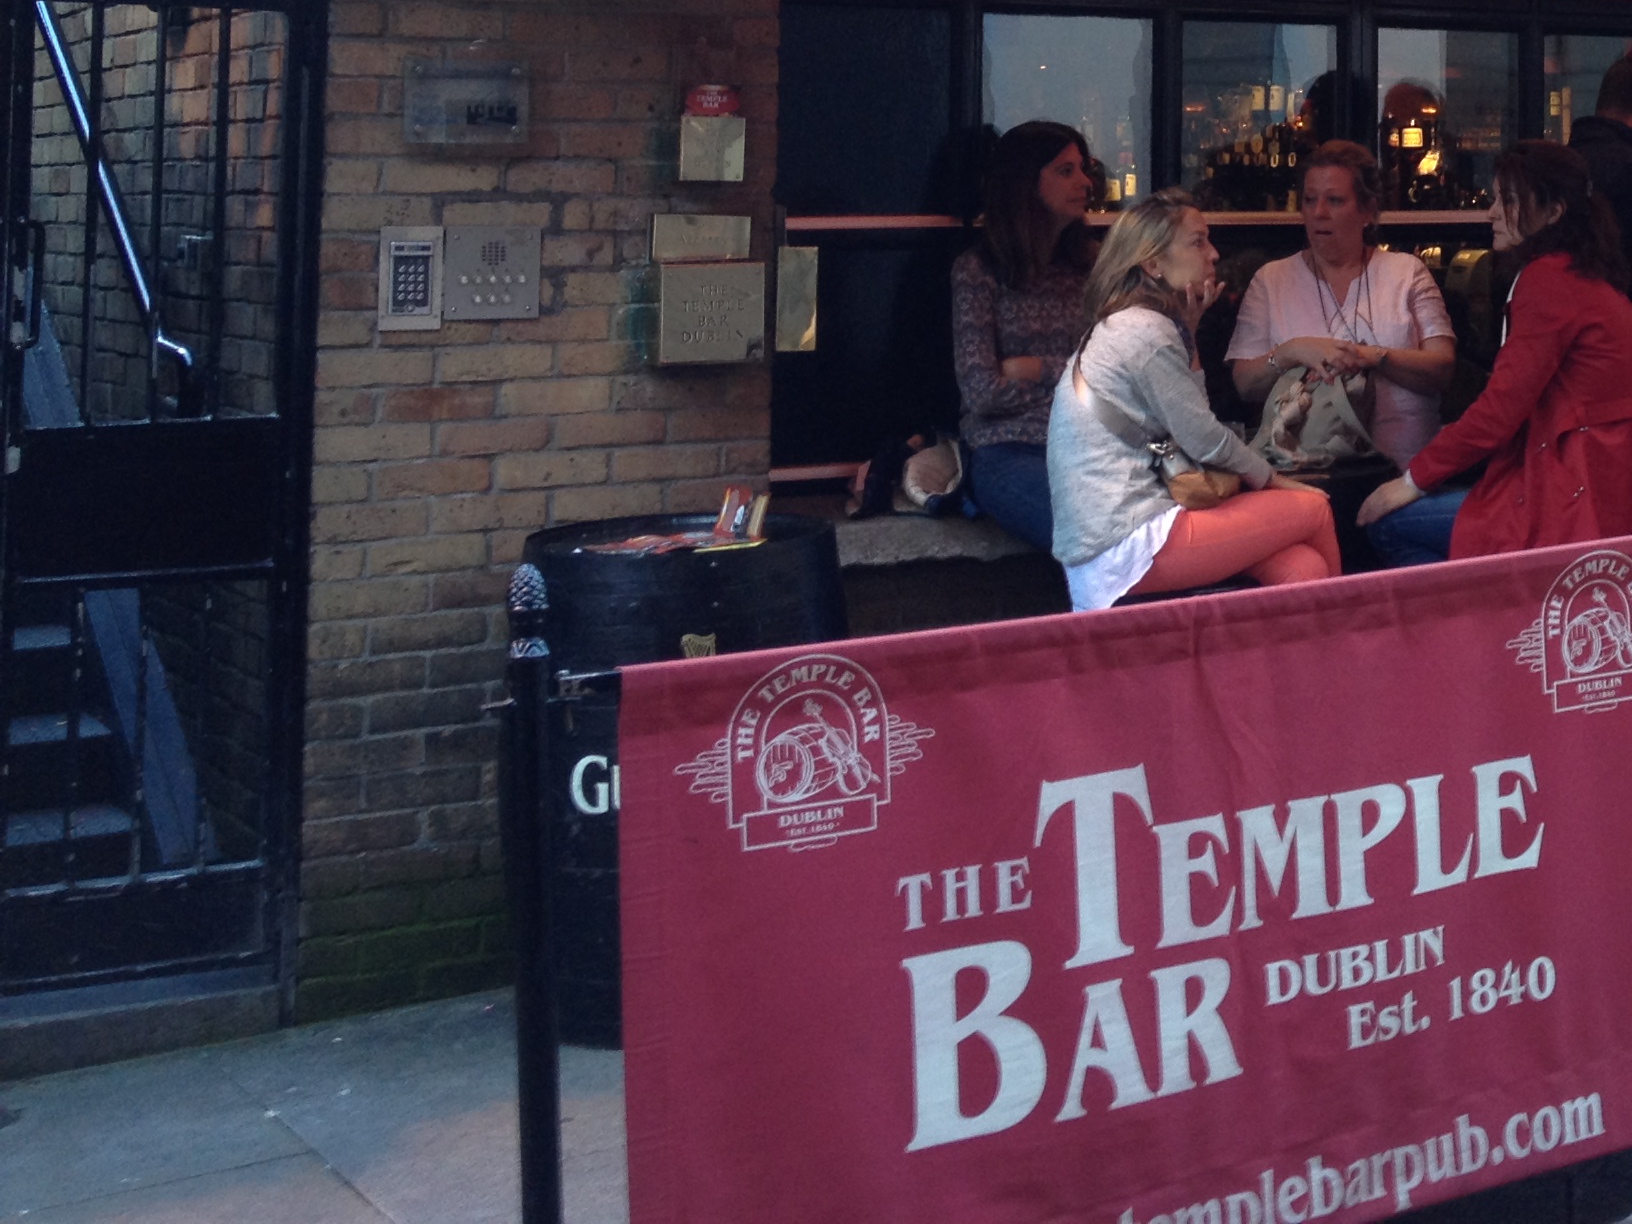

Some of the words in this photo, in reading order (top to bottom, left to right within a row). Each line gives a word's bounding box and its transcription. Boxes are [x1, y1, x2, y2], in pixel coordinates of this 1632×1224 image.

[696, 95, 728, 103] TEMPLE
[700, 283, 729, 297] THE
[682, 297, 745, 313] TEMPLE
[697, 313, 729, 329] BAR
[681, 329, 745, 345] DUBLIN
[1548, 594, 1565, 639] THE
[1562, 558, 1631, 590] TEMPLE
[1577, 676, 1623, 694] DUBLIN
[736, 708, 761, 763] THE
[758, 664, 856, 704] TEMPLE
[853, 686, 881, 744] BAR
[778, 806, 844, 828] DUBLIN
[896, 856, 1033, 933] THE
[1034, 753, 1546, 970] TEMPLE
[1346, 997, 1432, 1051] Est.
[1447, 956, 1558, 1024] 1840
[901, 939, 1245, 1154] BAR
[1263, 924, 1447, 1007] DUBLIN
